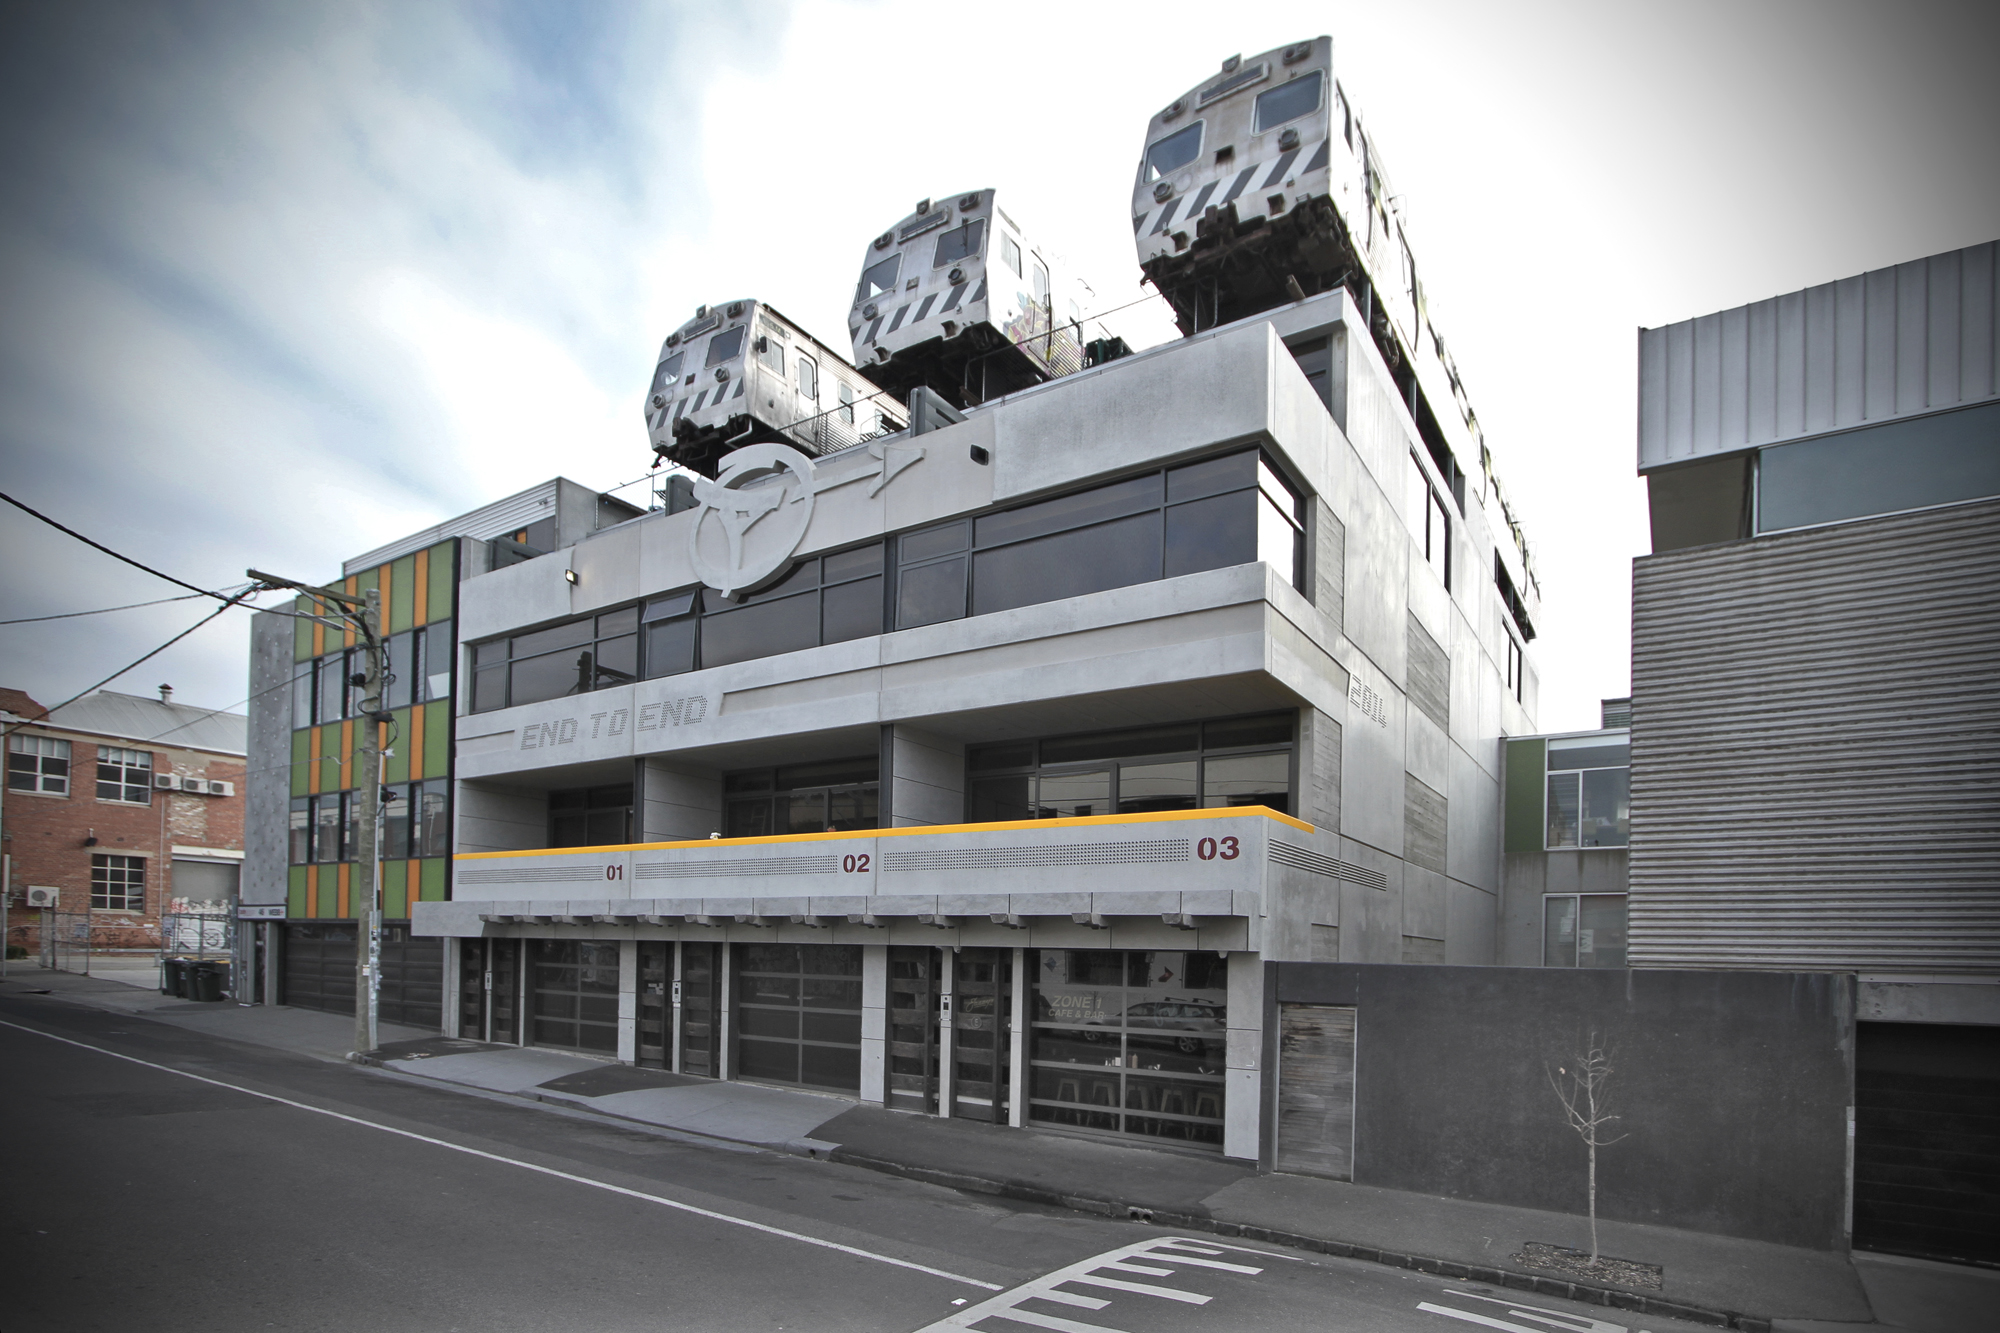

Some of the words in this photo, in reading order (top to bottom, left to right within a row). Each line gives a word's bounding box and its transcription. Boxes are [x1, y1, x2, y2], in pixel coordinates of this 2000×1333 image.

[1350, 673, 1387, 728] 2014
[520, 718, 579, 750] END
[590, 708, 628, 739] TO
[637, 695, 708, 732] END
[1197, 835, 1240, 861] 03
[606, 864, 623, 881] 01
[843, 853, 870, 873] 02
[1051, 995, 1092, 1009] ZONE
[1096, 997, 1102, 1009] 1
[1048, 1008, 1073, 1018] CAFE
[1075, 1010, 1082, 1018] &
[1084, 1010, 1104, 1019] BAR
